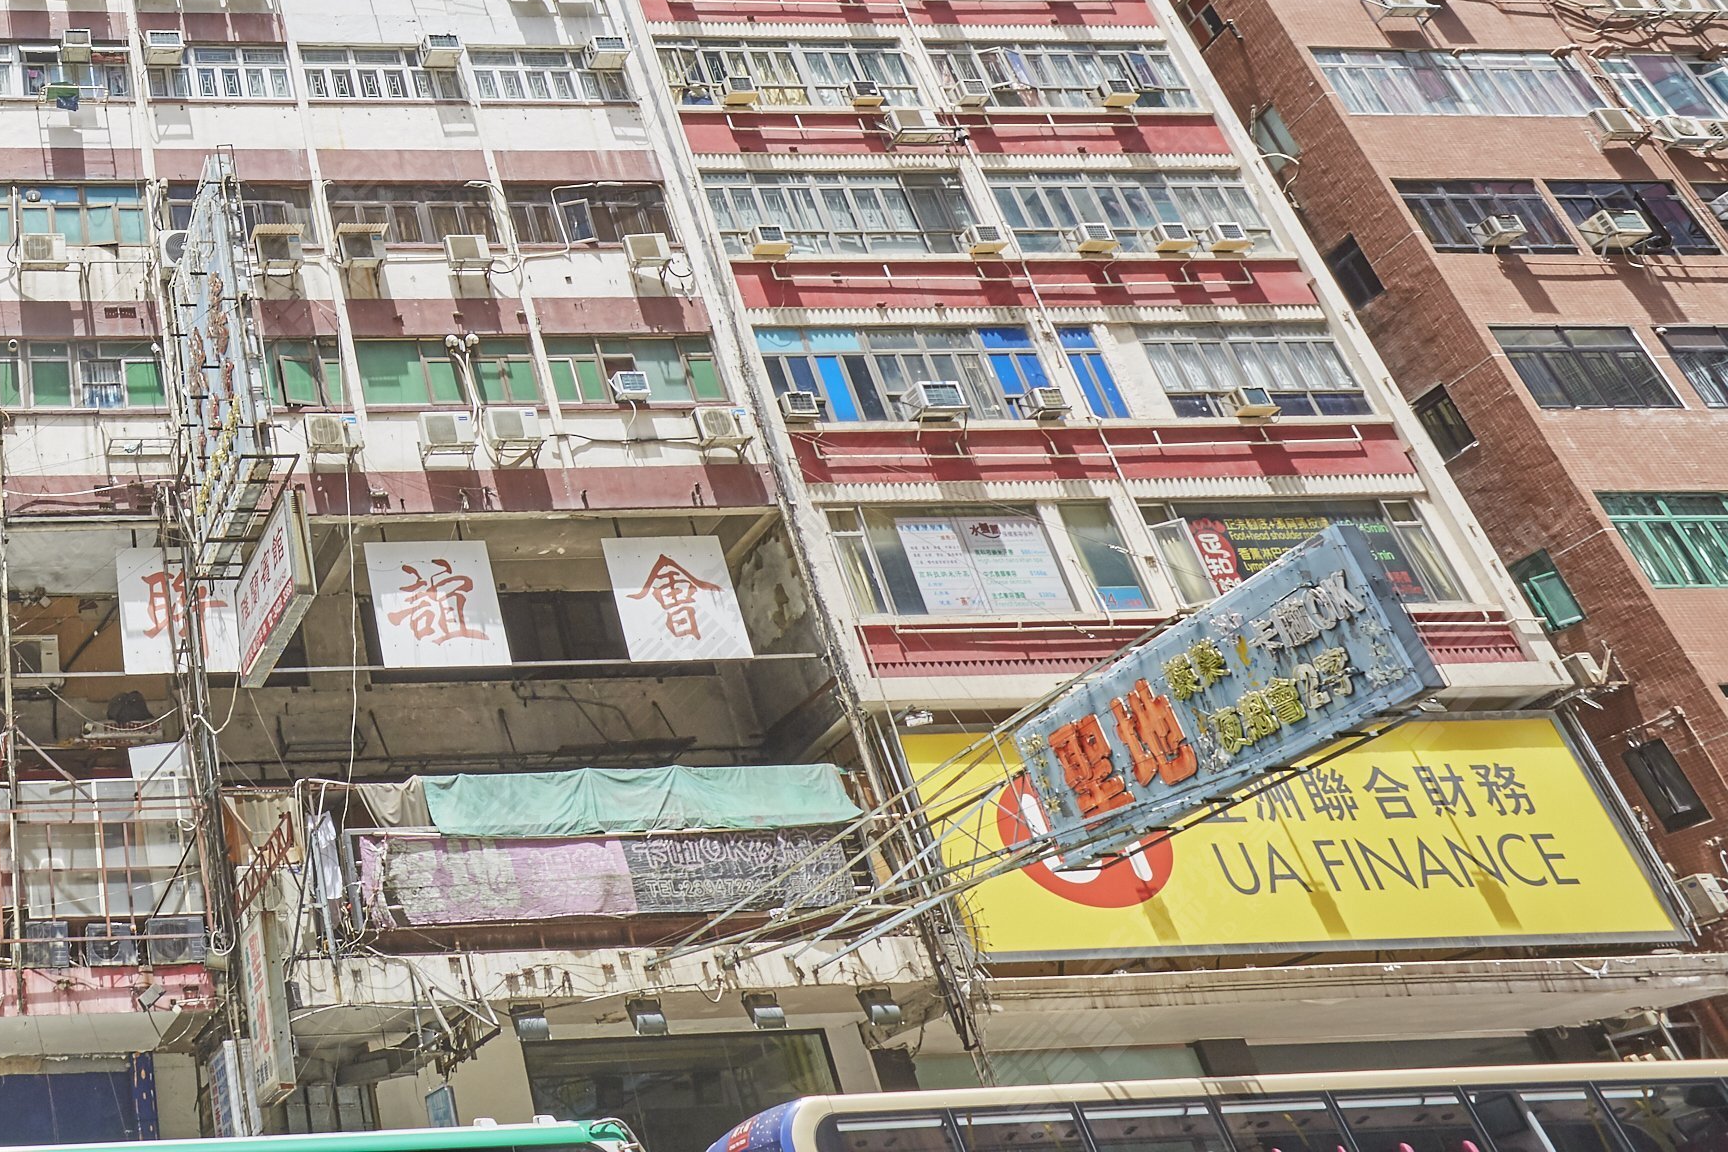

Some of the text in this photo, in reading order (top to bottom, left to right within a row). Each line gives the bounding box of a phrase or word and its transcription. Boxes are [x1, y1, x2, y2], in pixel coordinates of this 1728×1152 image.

[387, 558, 490, 646] 誼
[626, 553, 725, 642] 會
[1211, 832, 1581, 896] UA FINANCE
